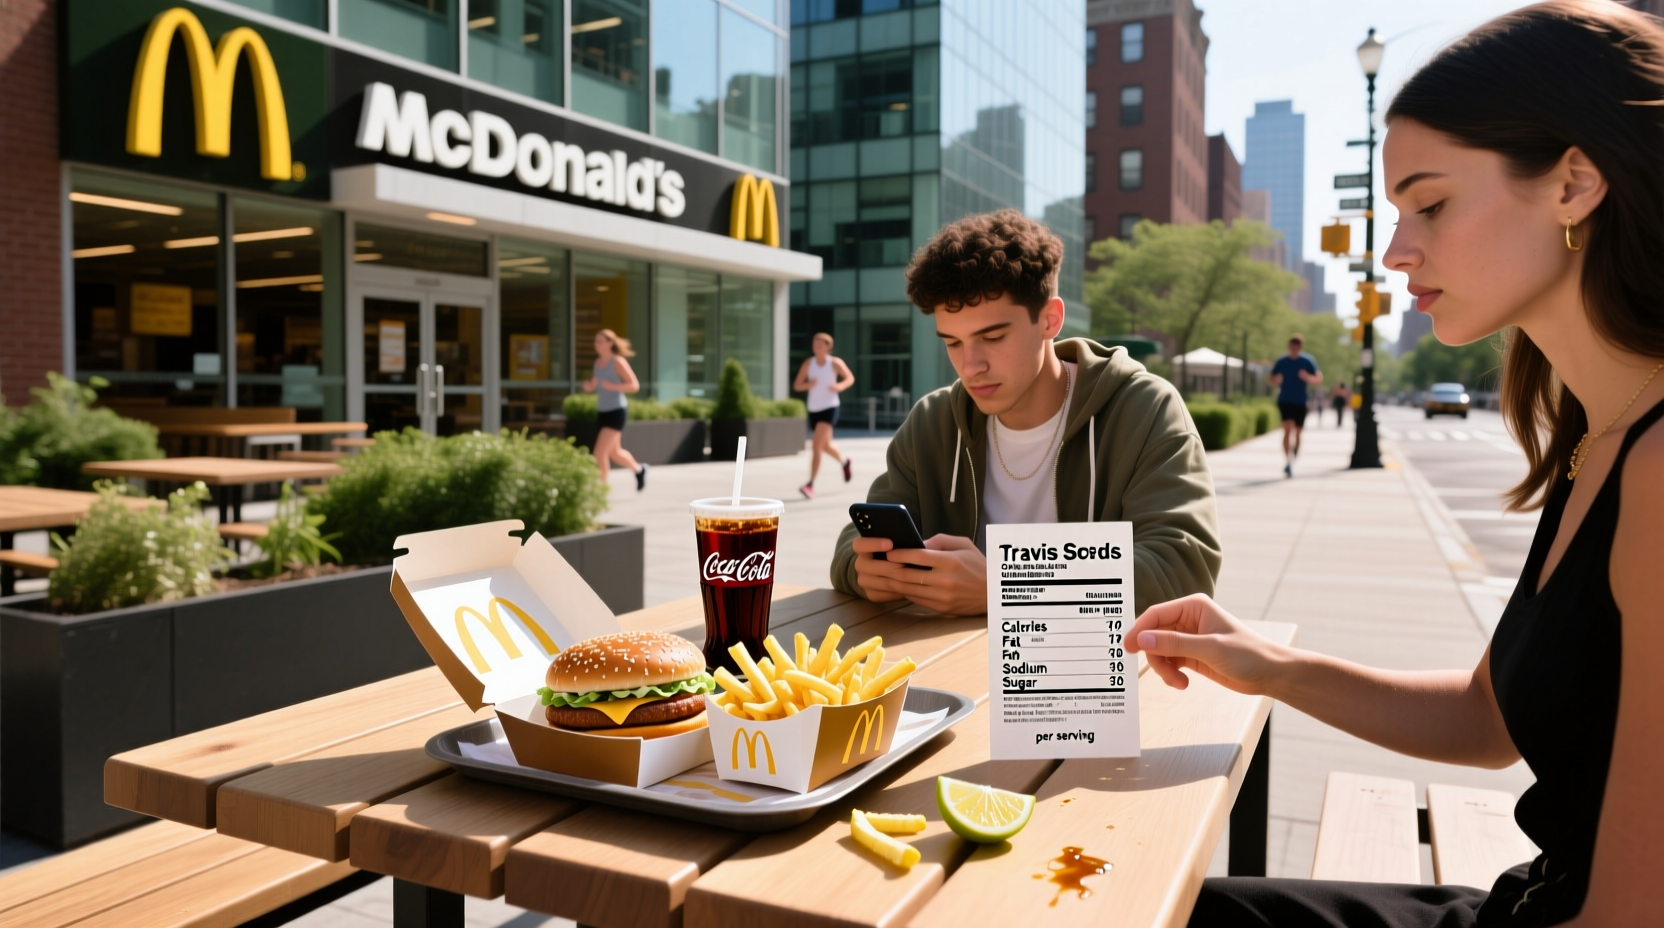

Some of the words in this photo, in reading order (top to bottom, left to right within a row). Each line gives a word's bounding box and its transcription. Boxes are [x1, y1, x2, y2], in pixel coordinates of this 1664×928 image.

[355, 81, 686, 218] McDonald's
[999, 543, 1058, 562] Travis
[1002, 676, 1038, 691] Sugar
[1035, 733, 1054, 745] per
